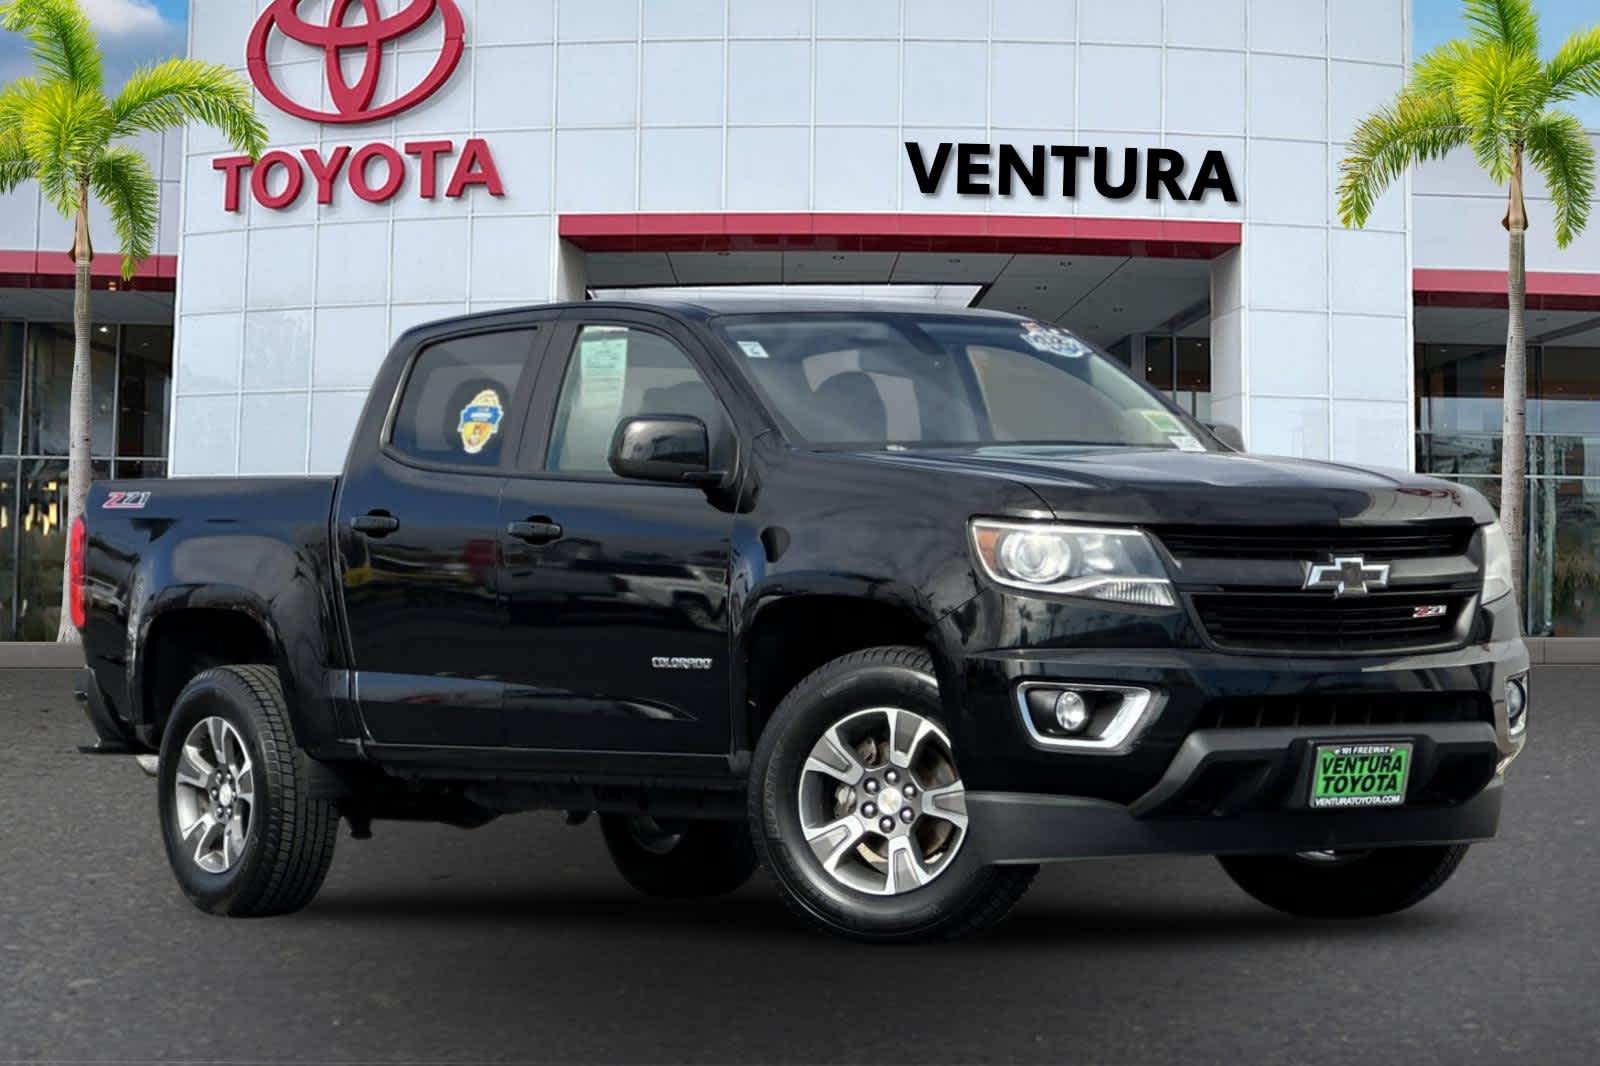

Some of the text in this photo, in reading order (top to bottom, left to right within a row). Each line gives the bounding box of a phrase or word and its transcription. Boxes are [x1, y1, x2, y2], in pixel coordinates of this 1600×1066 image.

[213, 138, 505, 212] TOYOTA
[904, 142, 1238, 202] VENTURA
[102, 491, 152, 508] Z71
[1413, 605, 1447, 618] Z71
[651, 657, 713, 669] COLORADO
[1353, 746, 1389, 754] FREEWAY
[1322, 755, 1403, 774] VENTURA
[1322, 774, 1397, 793] TOYOTA
[1315, 795, 1401, 806] VENTURATOYOTA.COM
